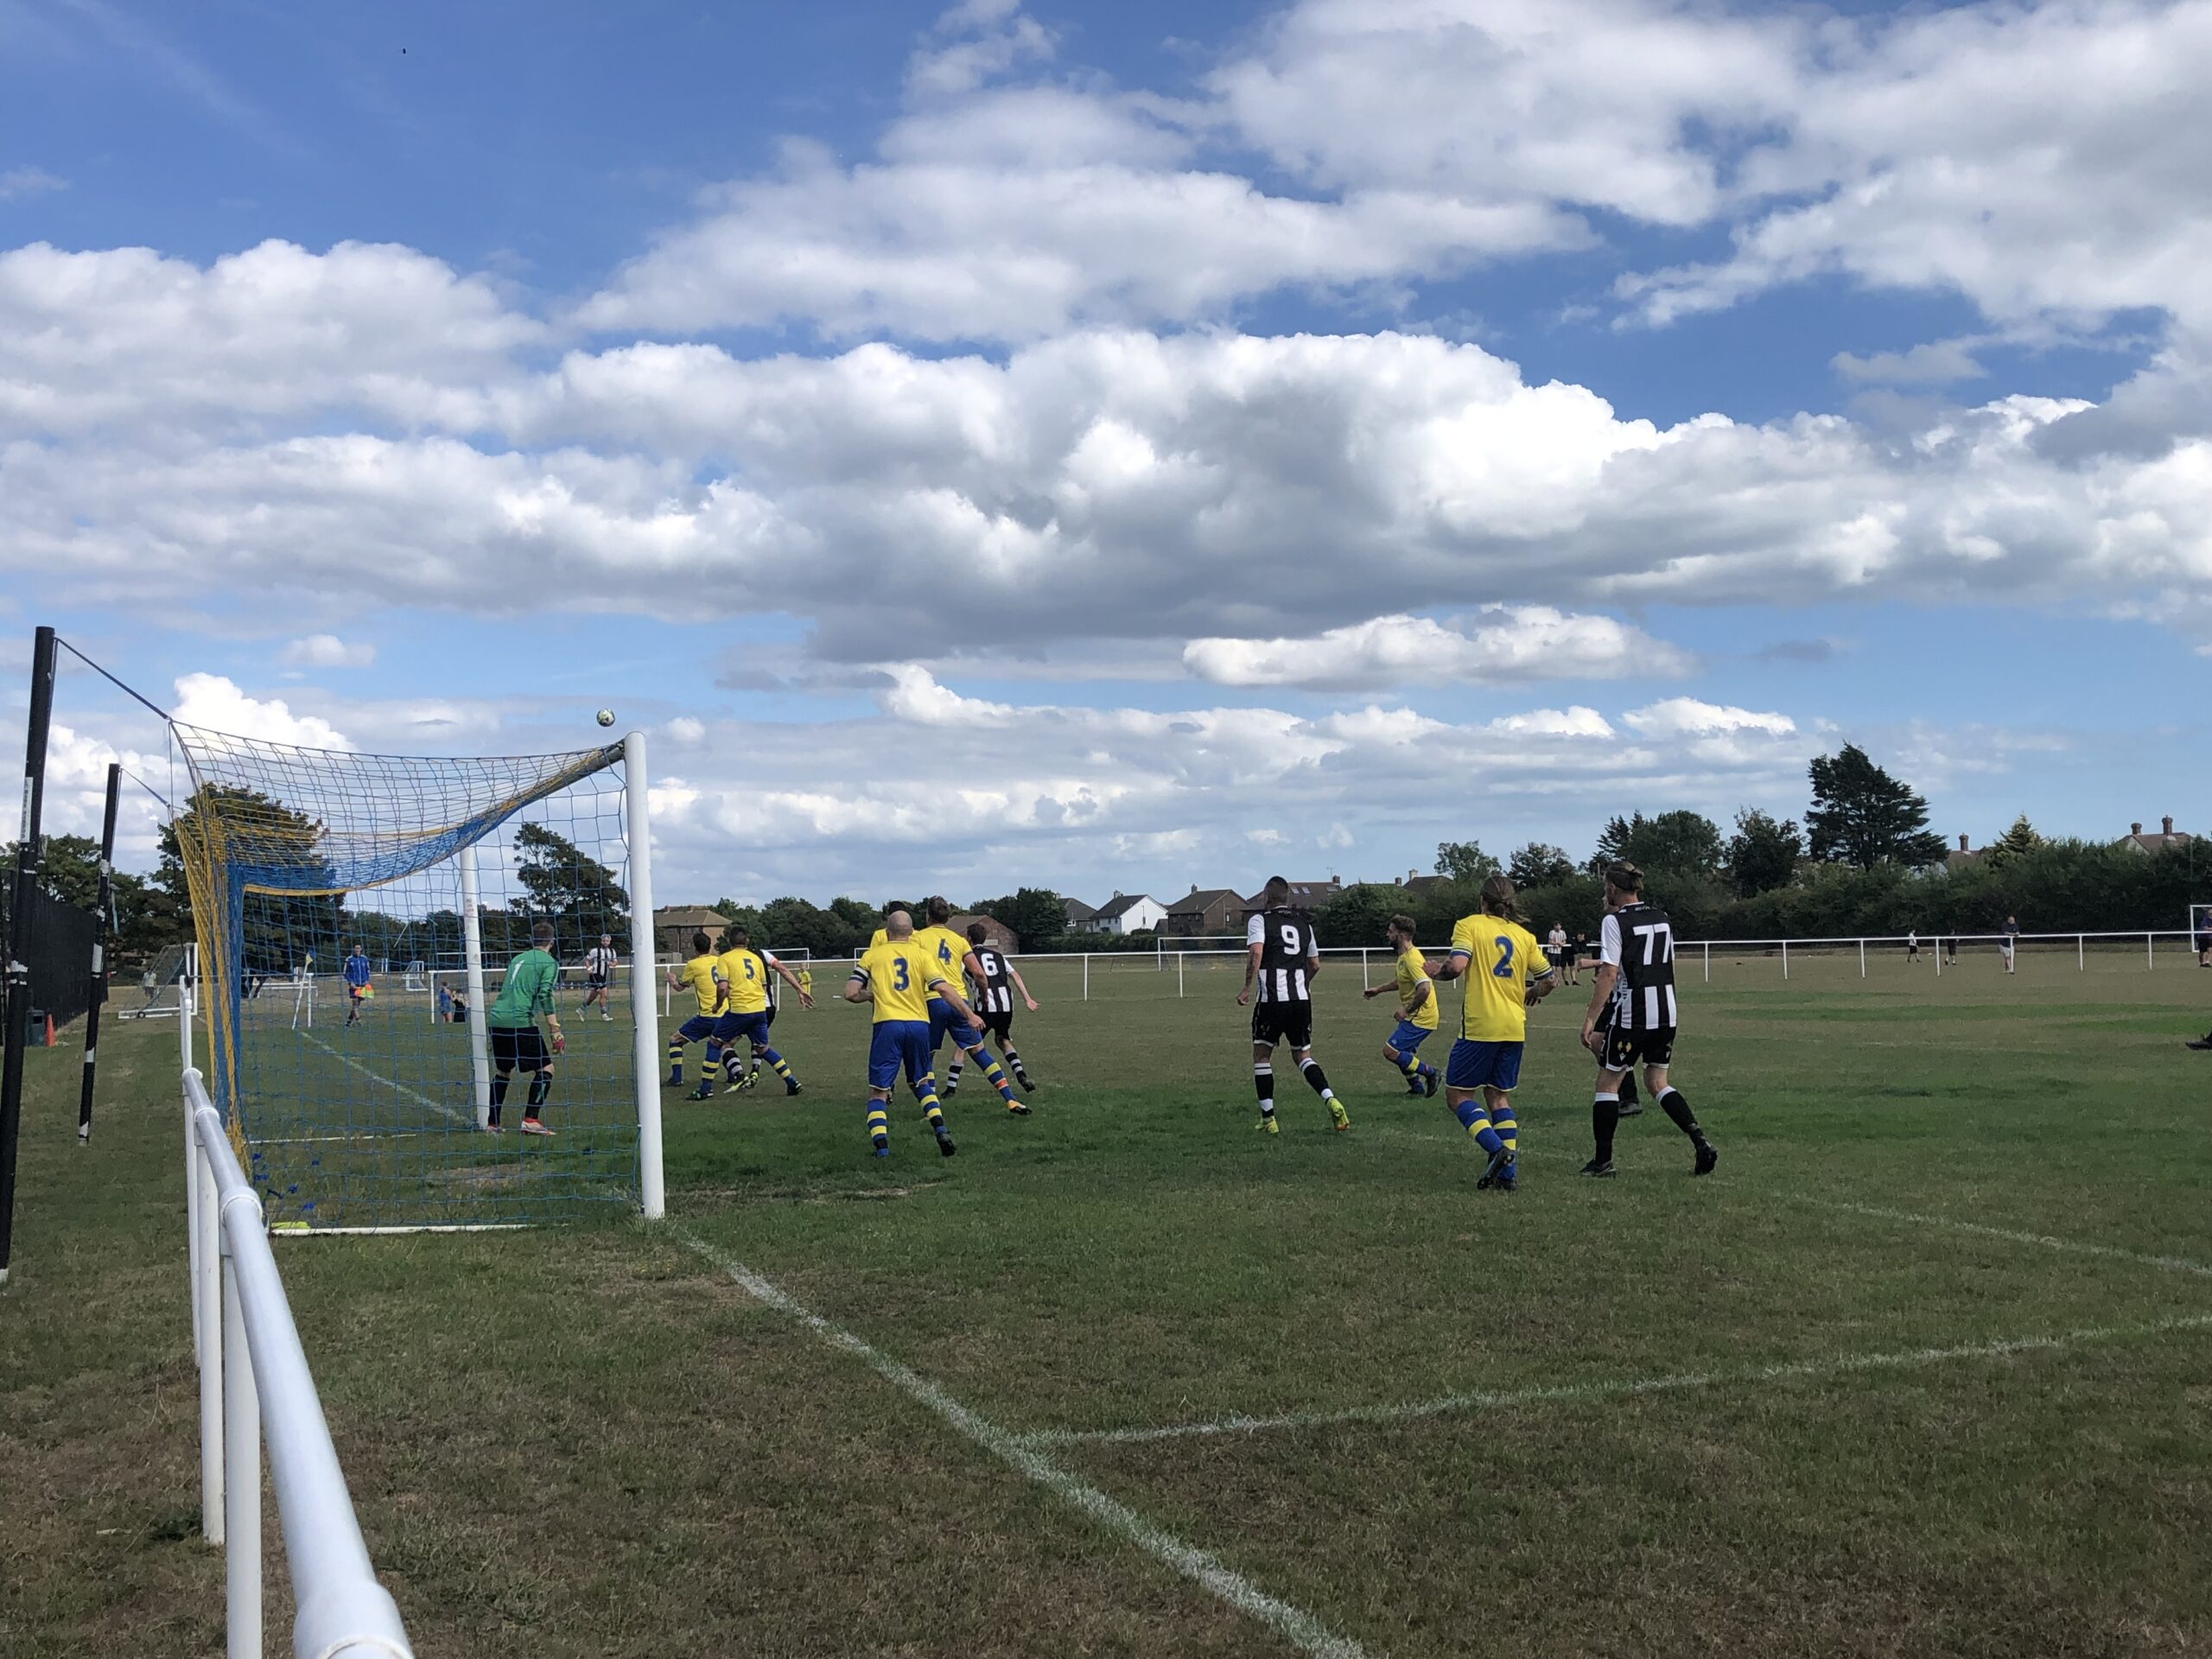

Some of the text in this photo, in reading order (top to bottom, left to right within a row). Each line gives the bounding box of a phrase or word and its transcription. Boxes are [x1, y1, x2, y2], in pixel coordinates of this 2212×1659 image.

[938, 938, 951, 965] 4
[1281, 925, 1300, 955] 9
[1633, 923, 1670, 965] 77
[743, 958, 754, 980] 5
[981, 953, 999, 976] 6
[1493, 936, 1513, 977] 2
[893, 957, 909, 991] 3
